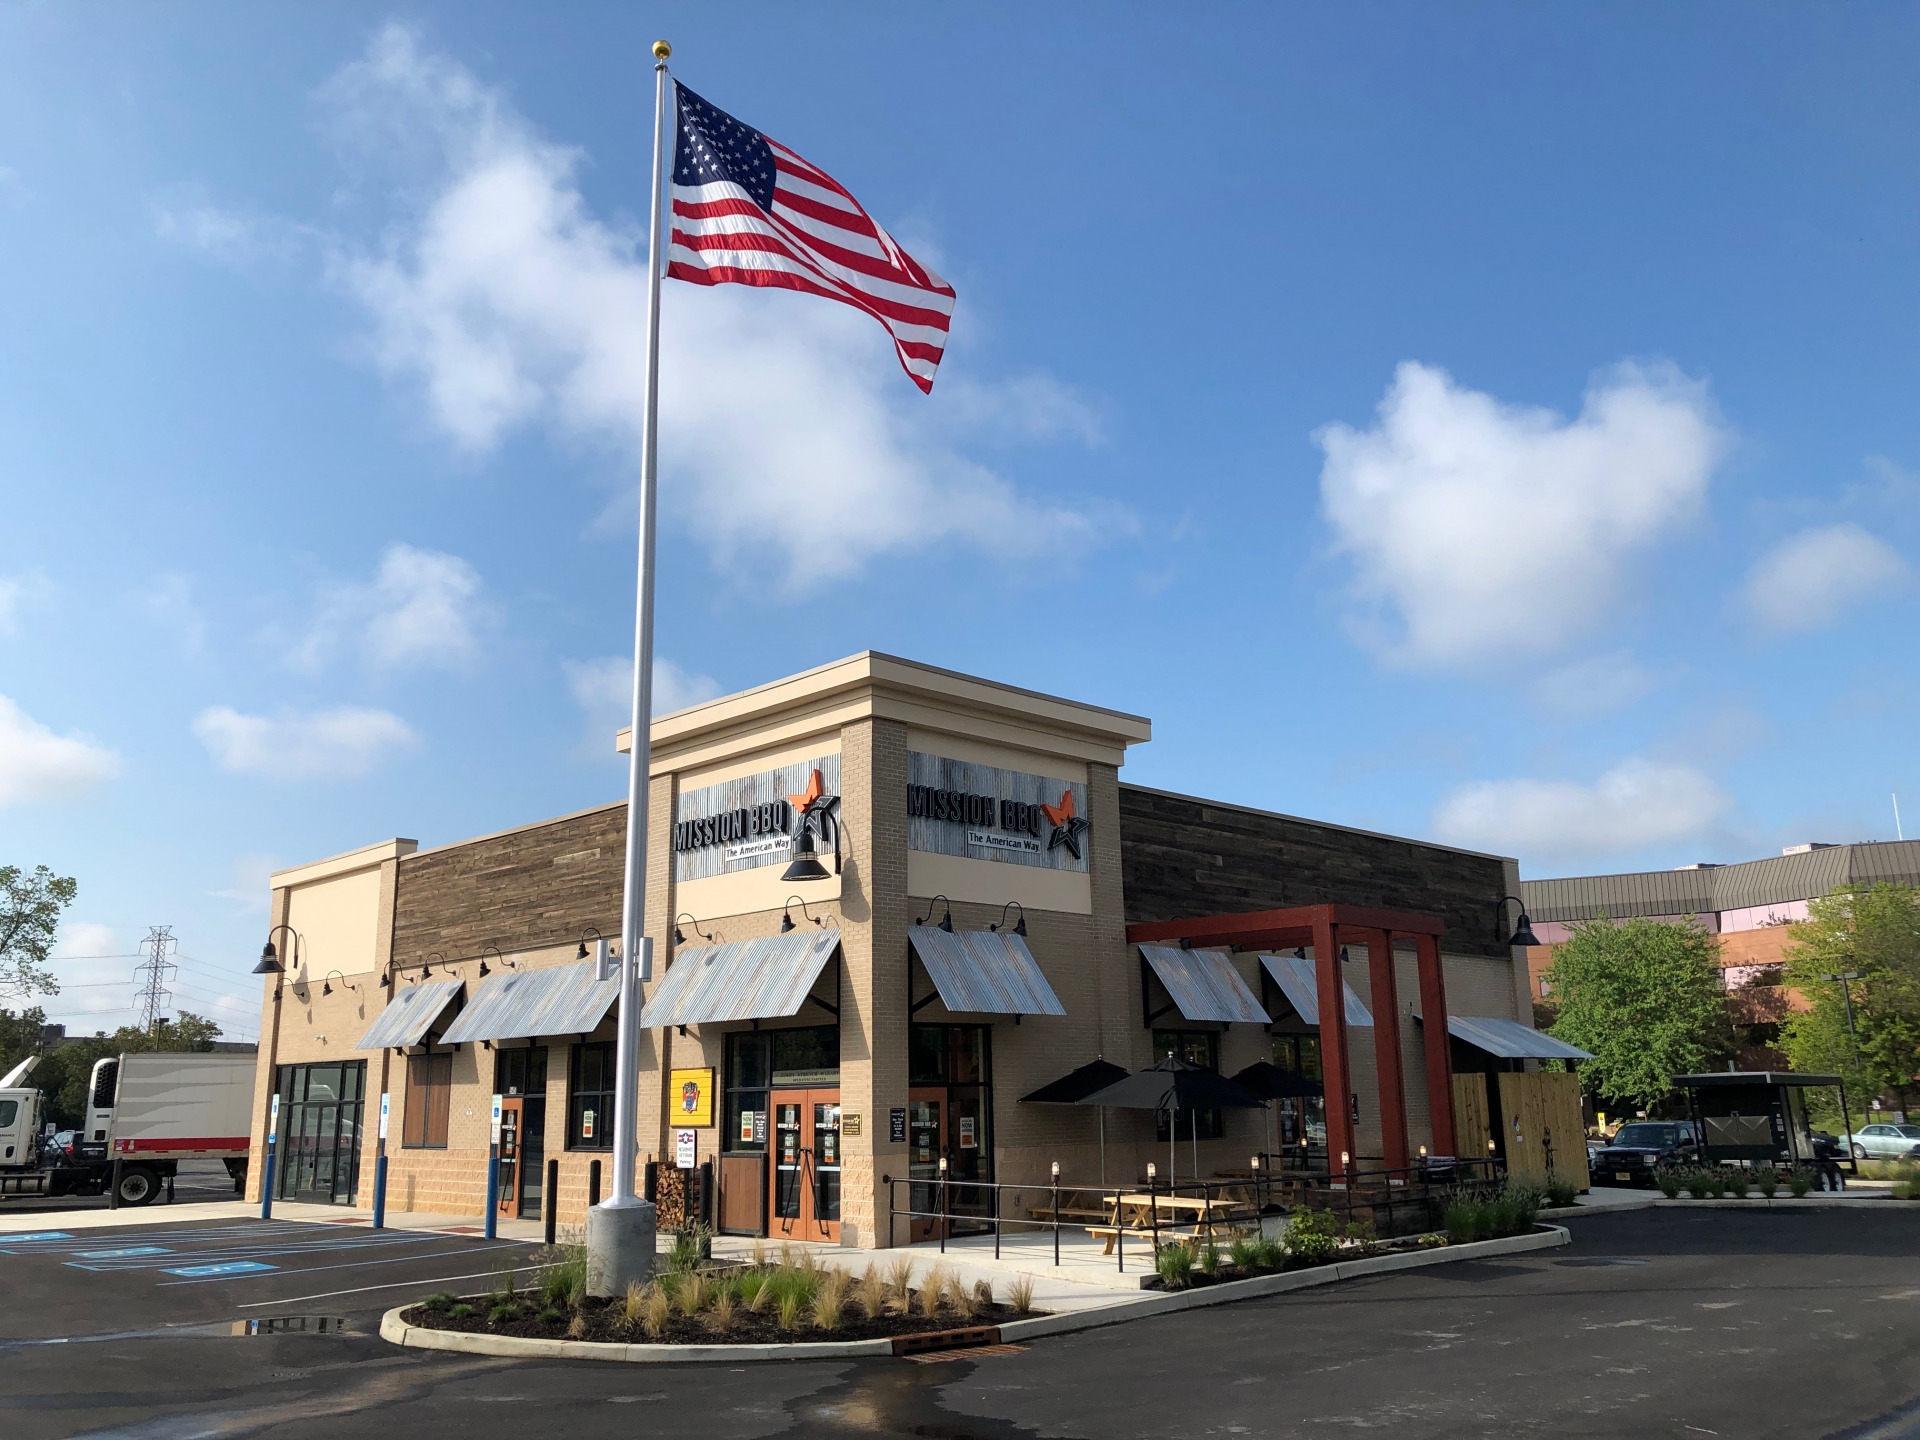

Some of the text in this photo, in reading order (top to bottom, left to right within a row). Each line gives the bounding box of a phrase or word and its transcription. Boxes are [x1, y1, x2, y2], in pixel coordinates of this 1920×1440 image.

[672, 798, 788, 852] MISSION BBQ
[907, 783, 1042, 838] MISSION BBQ
[726, 839, 790, 859] The American Way
[968, 832, 1040, 852] The American Way
